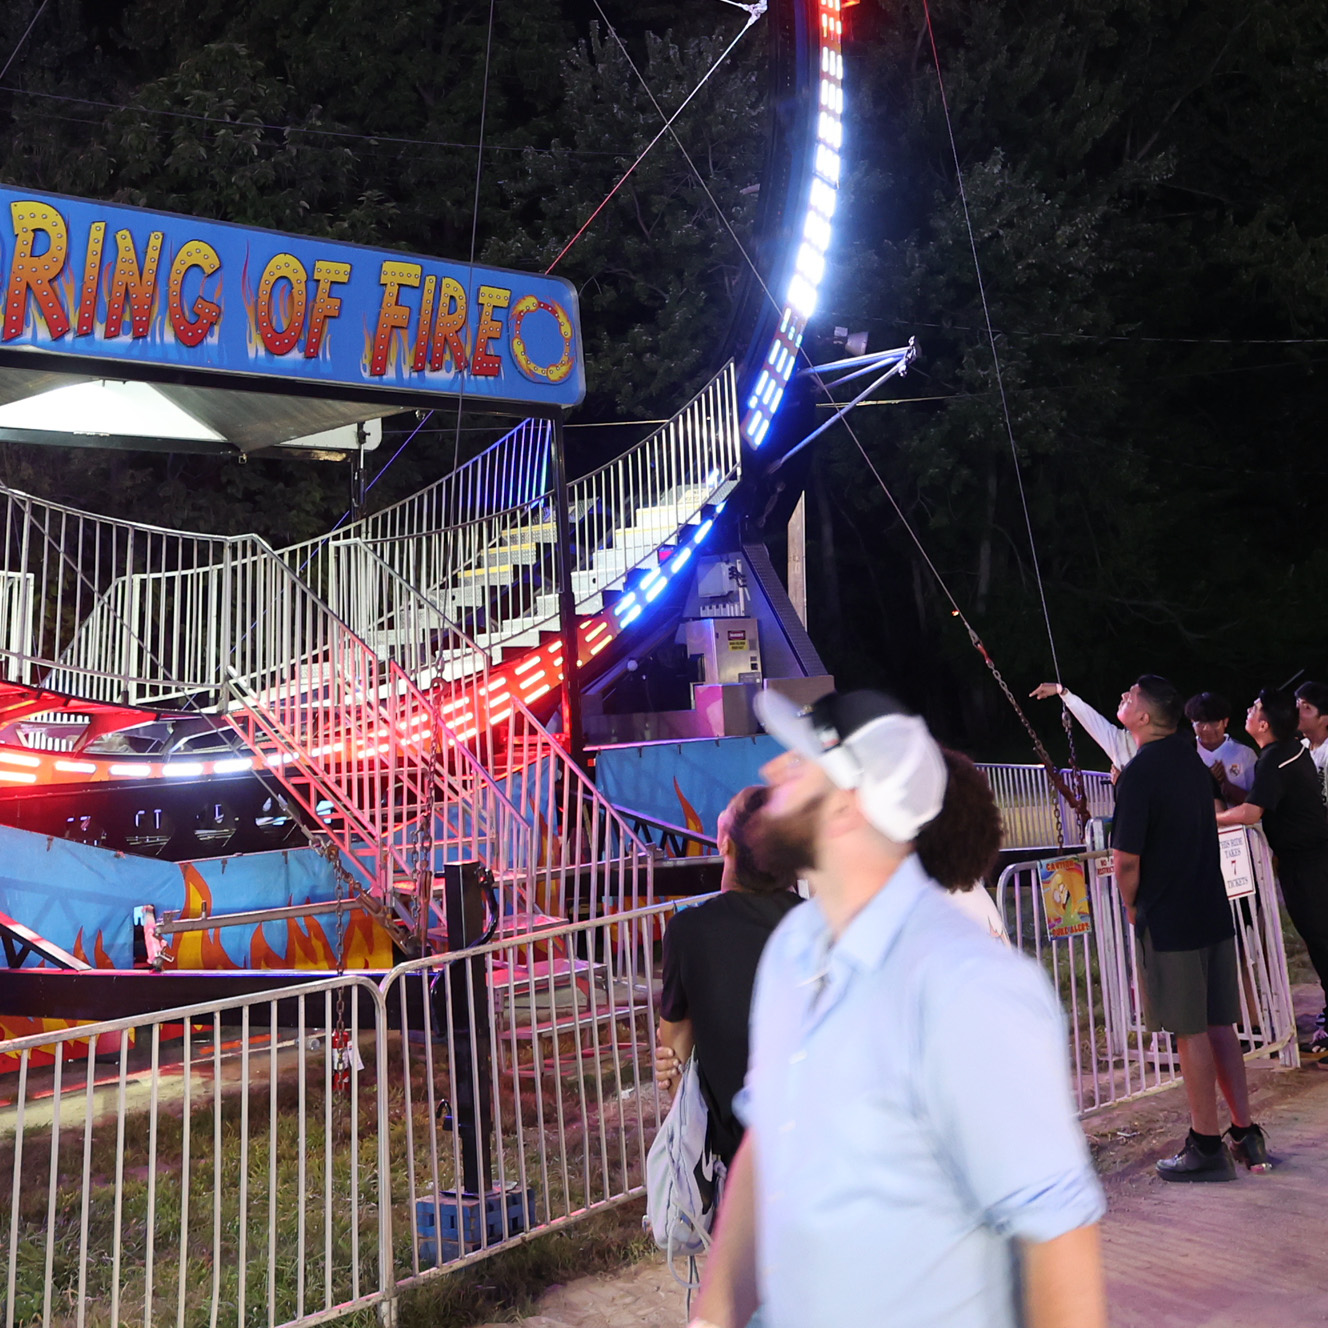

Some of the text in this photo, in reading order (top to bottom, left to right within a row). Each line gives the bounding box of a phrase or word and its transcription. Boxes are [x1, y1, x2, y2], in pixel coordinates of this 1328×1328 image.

[2, 200, 513, 377] RING OF FIRE
[1230, 837, 1243, 848] RIDE
[1224, 848, 1241, 859] TAKES
[1231, 860, 1237, 876] 7
[1227, 876, 1249, 889] TICKETS
